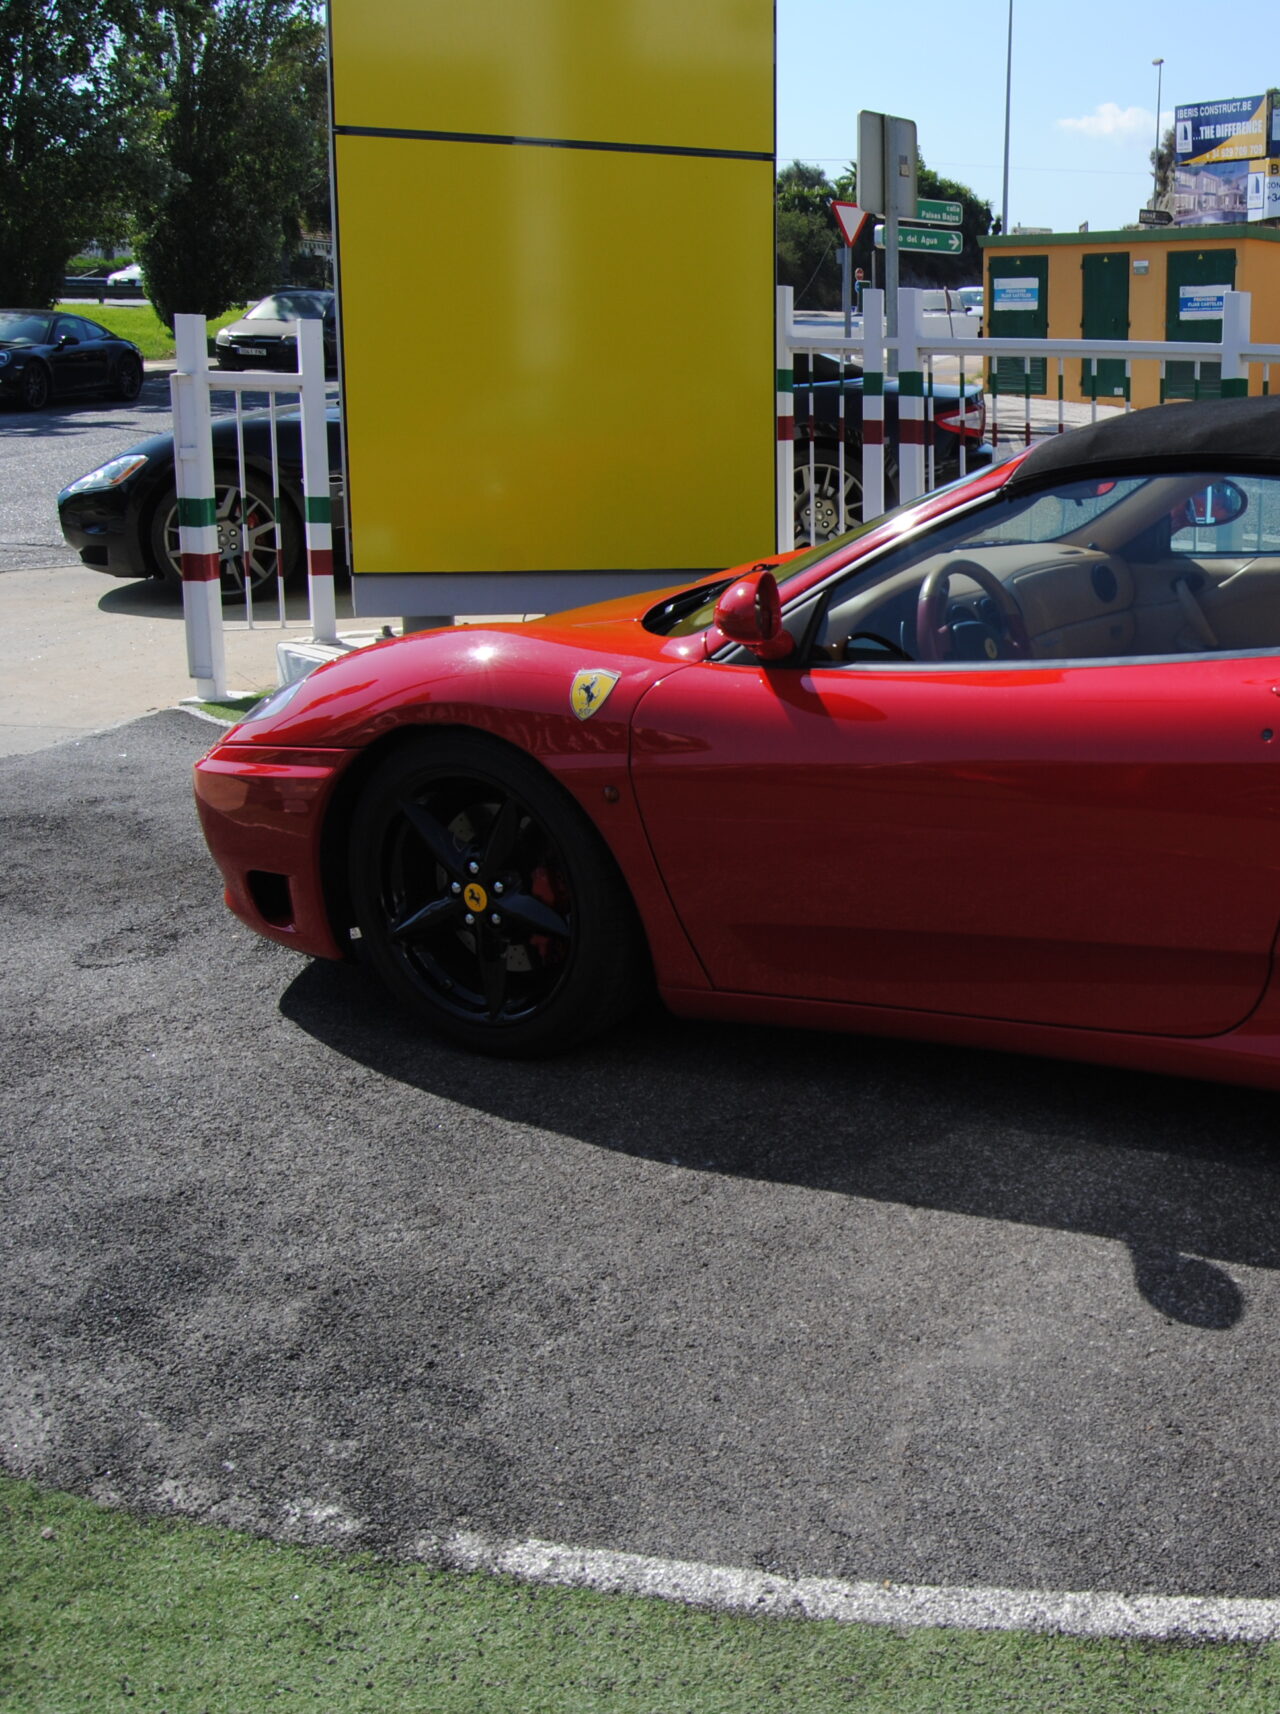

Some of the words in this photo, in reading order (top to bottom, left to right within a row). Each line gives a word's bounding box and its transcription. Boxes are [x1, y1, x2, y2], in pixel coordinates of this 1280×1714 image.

[1177, 107, 1199, 119] IBERIS
[1200, 100, 1252, 116] CONSTRUCT.BE
[1216, 119, 1263, 138] DIFFERENCE
[942, 212, 959, 221] Bajos
[906, 234, 918, 243] del
[920, 234, 938, 246] Agua
